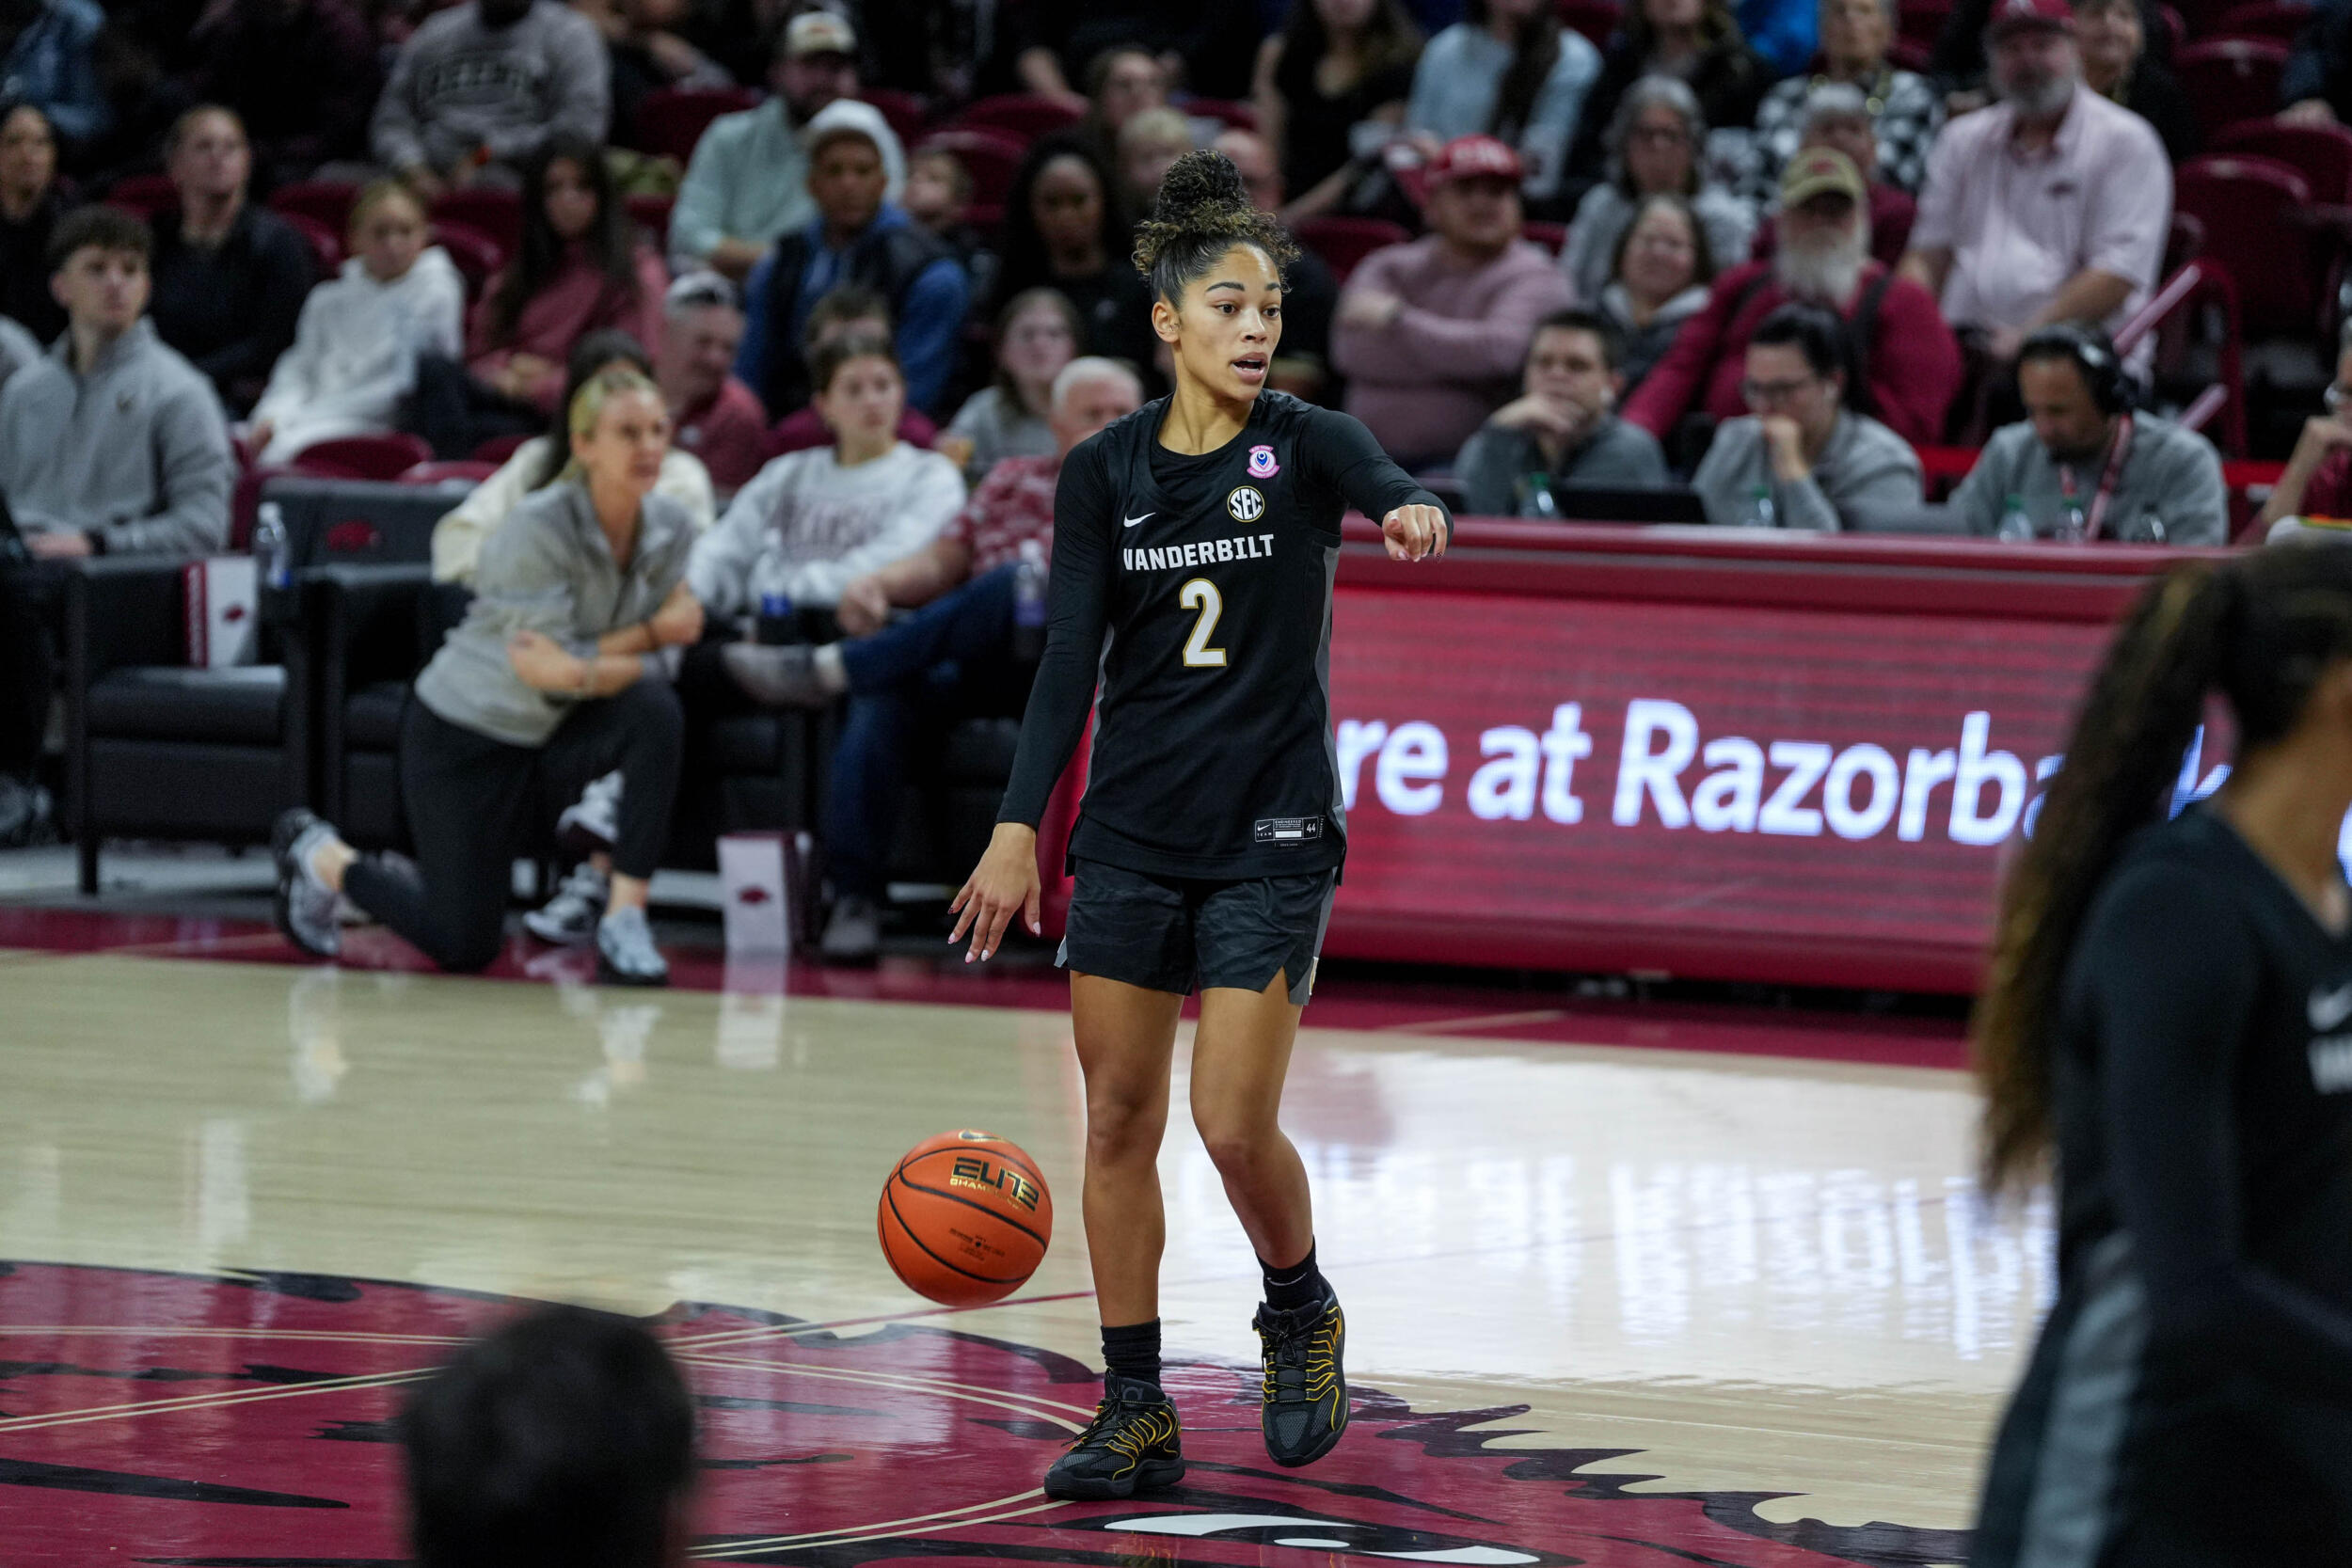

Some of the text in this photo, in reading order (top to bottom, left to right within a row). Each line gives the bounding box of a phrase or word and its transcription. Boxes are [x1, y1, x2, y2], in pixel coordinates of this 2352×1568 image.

[1230, 488, 1263, 520] SEC
[1123, 533, 1275, 571] VANDERBILT
[1179, 578, 1228, 667] 2
[1336, 720, 1450, 816] re
[1468, 702, 1593, 824] at
[1616, 698, 2233, 846] Razorb
[1306, 823, 1316, 833] 44
[952, 1156, 1040, 1212] ELITE
